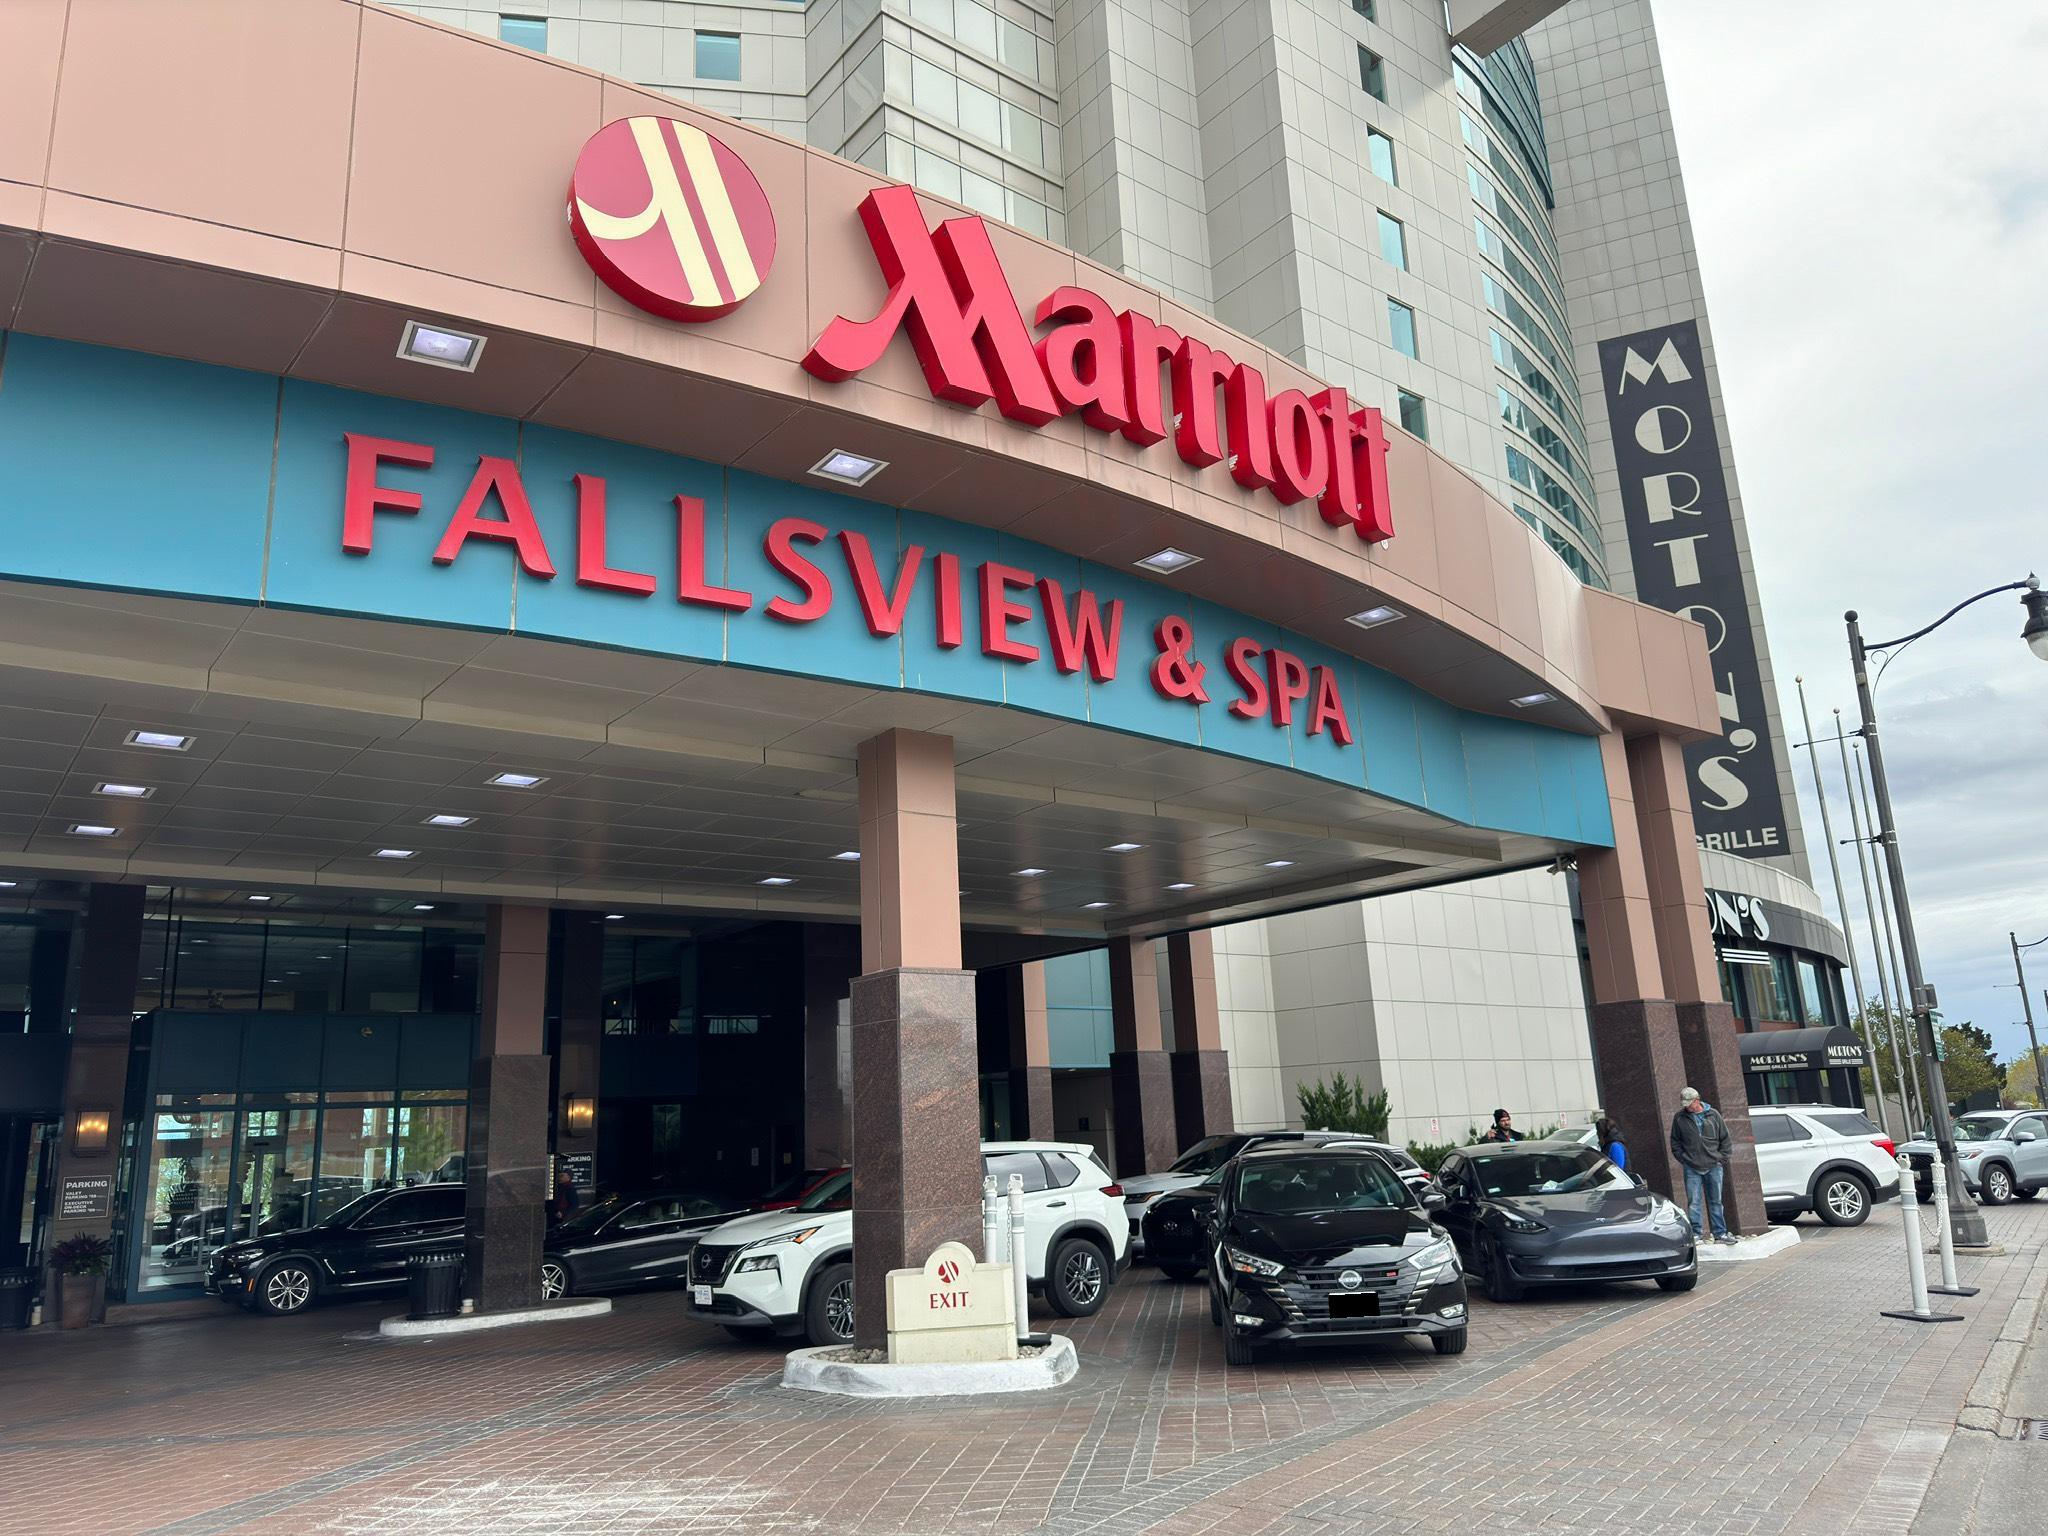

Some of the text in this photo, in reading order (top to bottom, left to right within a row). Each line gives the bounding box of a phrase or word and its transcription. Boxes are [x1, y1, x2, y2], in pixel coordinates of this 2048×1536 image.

[801, 184, 1395, 543] Marriott
[341, 432, 1355, 746] FALLSVIEW & SPA
[1750, 1053, 1808, 1065] MORTON'S
[1827, 1045, 1862, 1057] MORTON'S
[930, 1291, 969, 1309] EXIT
